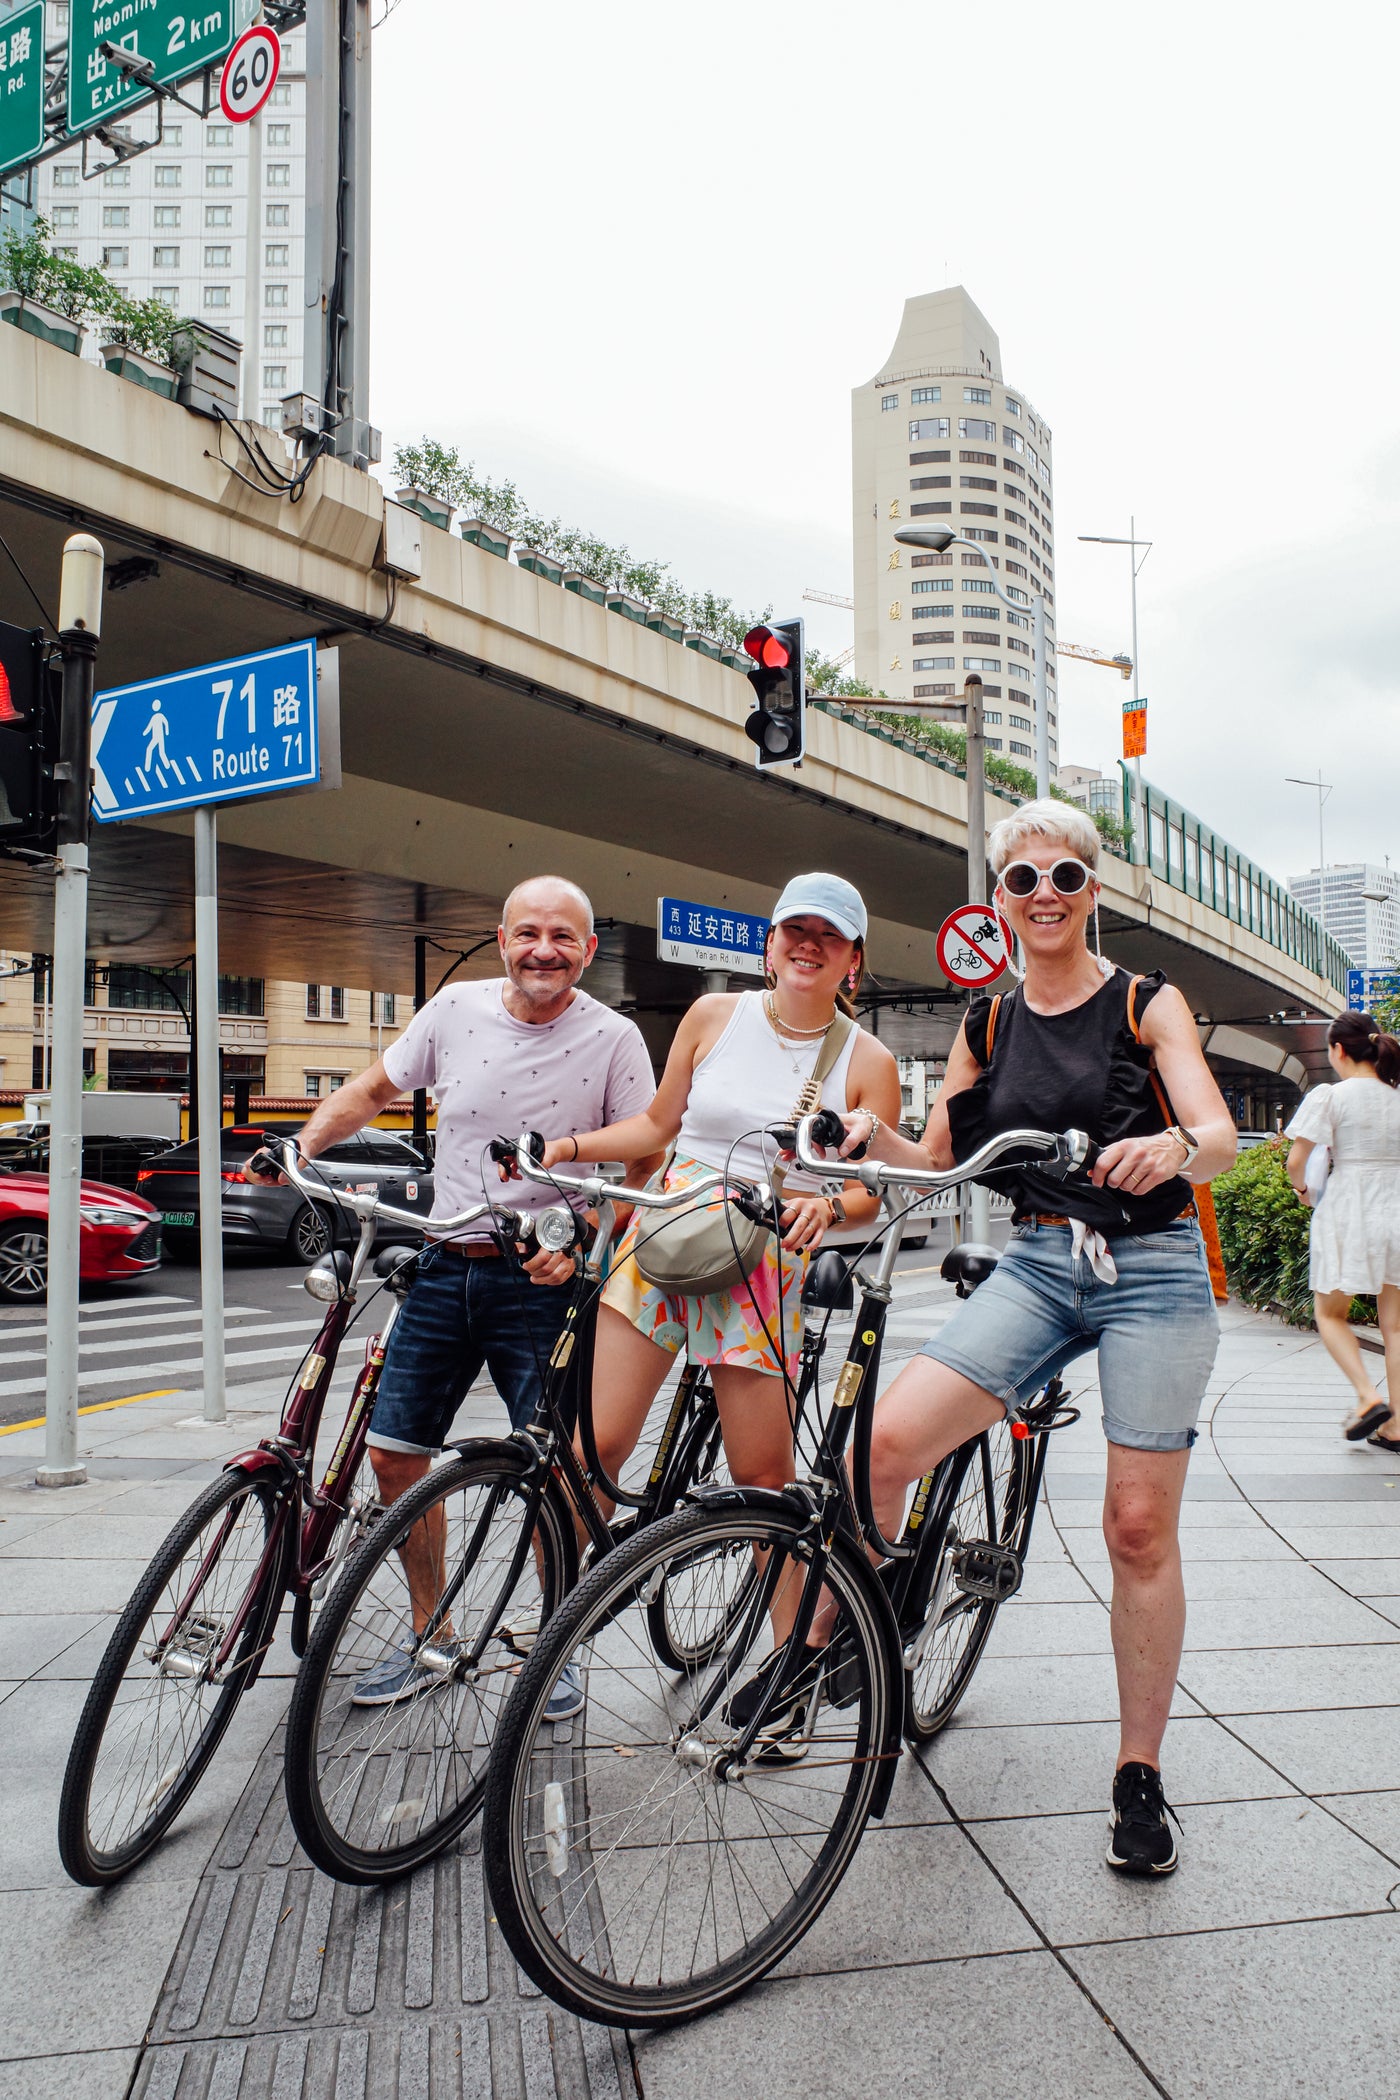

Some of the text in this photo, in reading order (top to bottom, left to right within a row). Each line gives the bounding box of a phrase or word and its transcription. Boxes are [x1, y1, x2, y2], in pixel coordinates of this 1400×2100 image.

[87, 29, 138, 84] 出口
[232, 46, 269, 101] 60
[8, 72, 26, 95] Rd.
[212, 732, 303, 780] Route 71
[670, 907, 680, 923] 西
[668, 924, 682, 936] 433
[688, 911, 750, 947] 延安西路
[756, 924, 764, 939] 东
[670, 944, 680, 958] W
[694, 948, 718, 961] Yan'an
[758, 959, 763, 971] E
[867, 1334, 873, 1342] B
